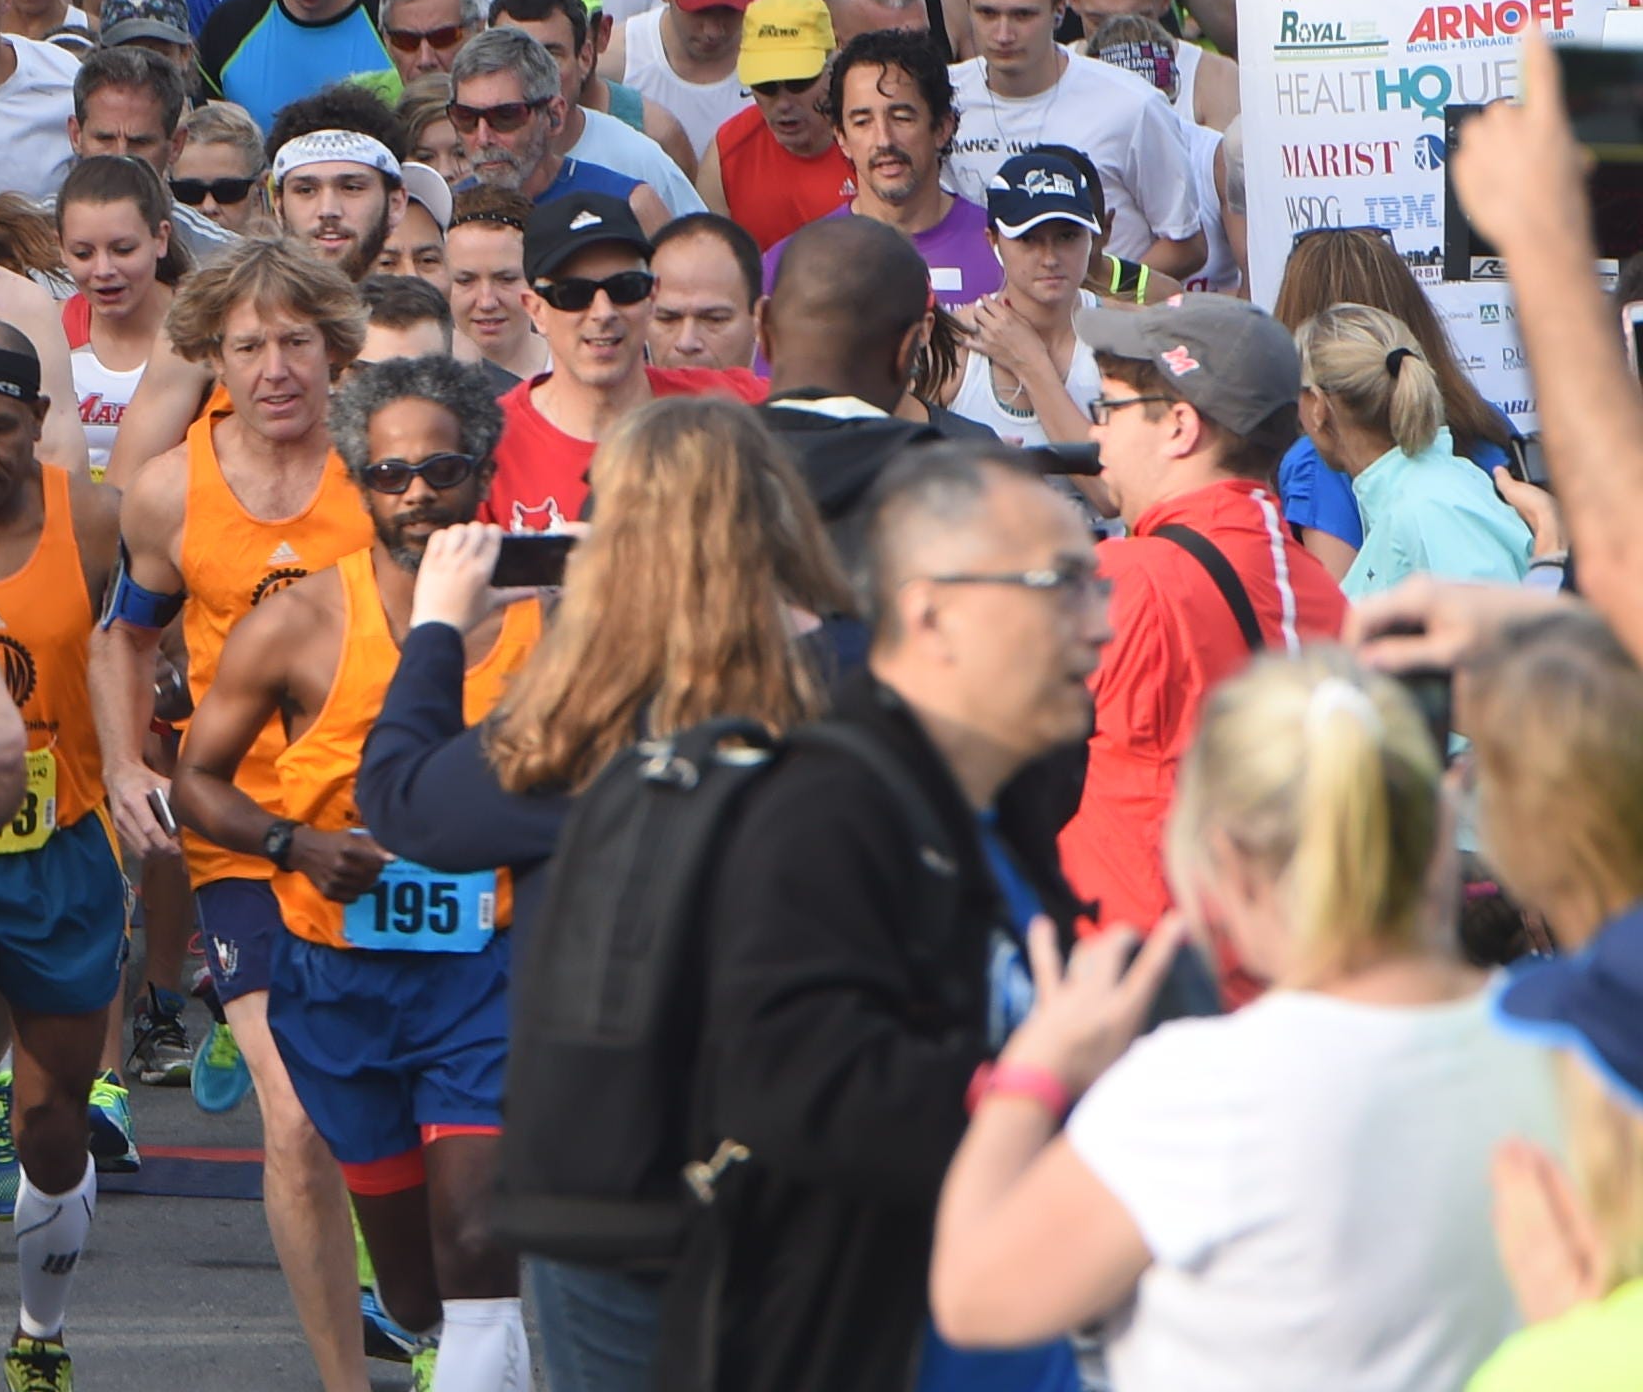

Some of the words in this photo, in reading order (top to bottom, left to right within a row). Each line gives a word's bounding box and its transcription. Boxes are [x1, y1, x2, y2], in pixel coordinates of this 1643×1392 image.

[1274, 58, 1519, 122] HEALTHQUE
[1281, 140, 1401, 179] MARIST
[1364, 193, 1437, 229] IBM
[374, 880, 460, 935] 195
